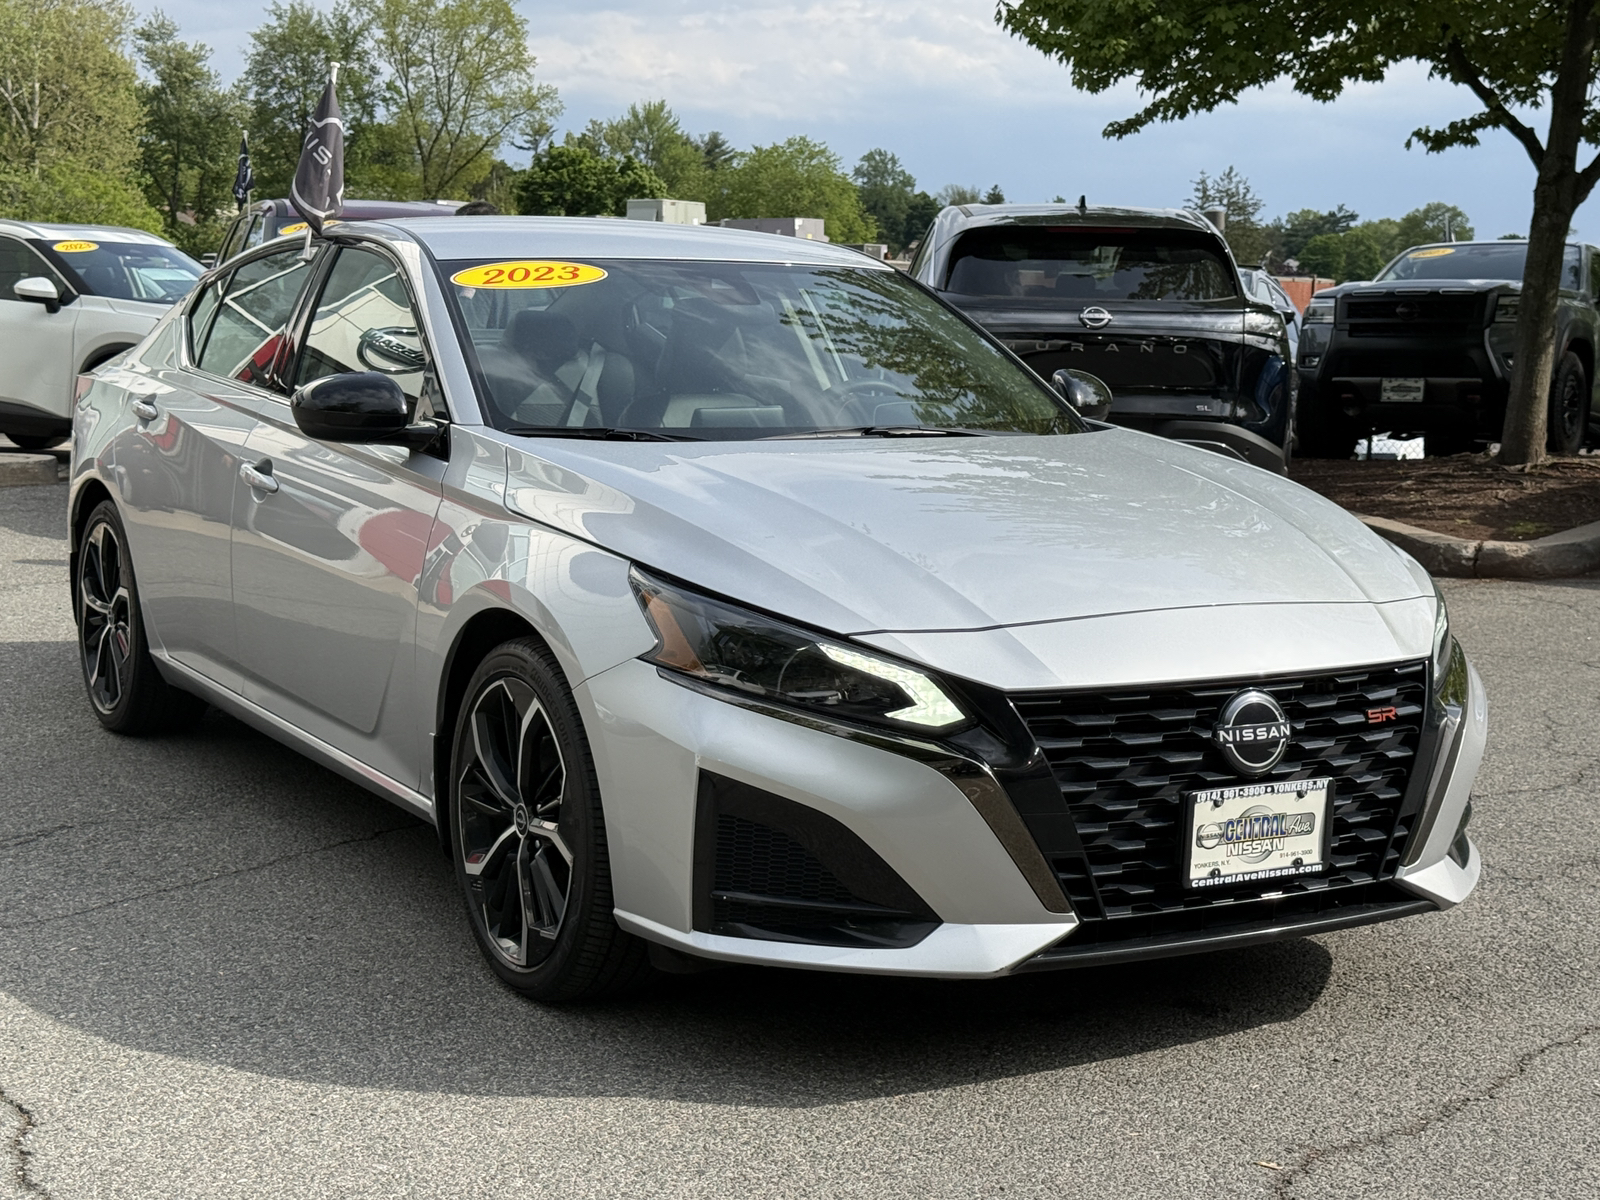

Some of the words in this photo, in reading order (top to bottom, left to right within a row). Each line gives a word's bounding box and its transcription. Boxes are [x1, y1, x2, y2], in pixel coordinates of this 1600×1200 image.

[482, 266, 581, 285] 2023
[1368, 706, 1397, 724] SR
[1218, 724, 1291, 743] NISSAN
[1196, 791, 1221, 803] (914)
[1224, 813, 1288, 843] CENTRAL
[1288, 815, 1312, 835] Ave.
[1226, 838, 1285, 857] NISSAN
[1279, 849, 1313, 858] 914-961-3900
[1194, 861, 1220, 870] YONKERS,
